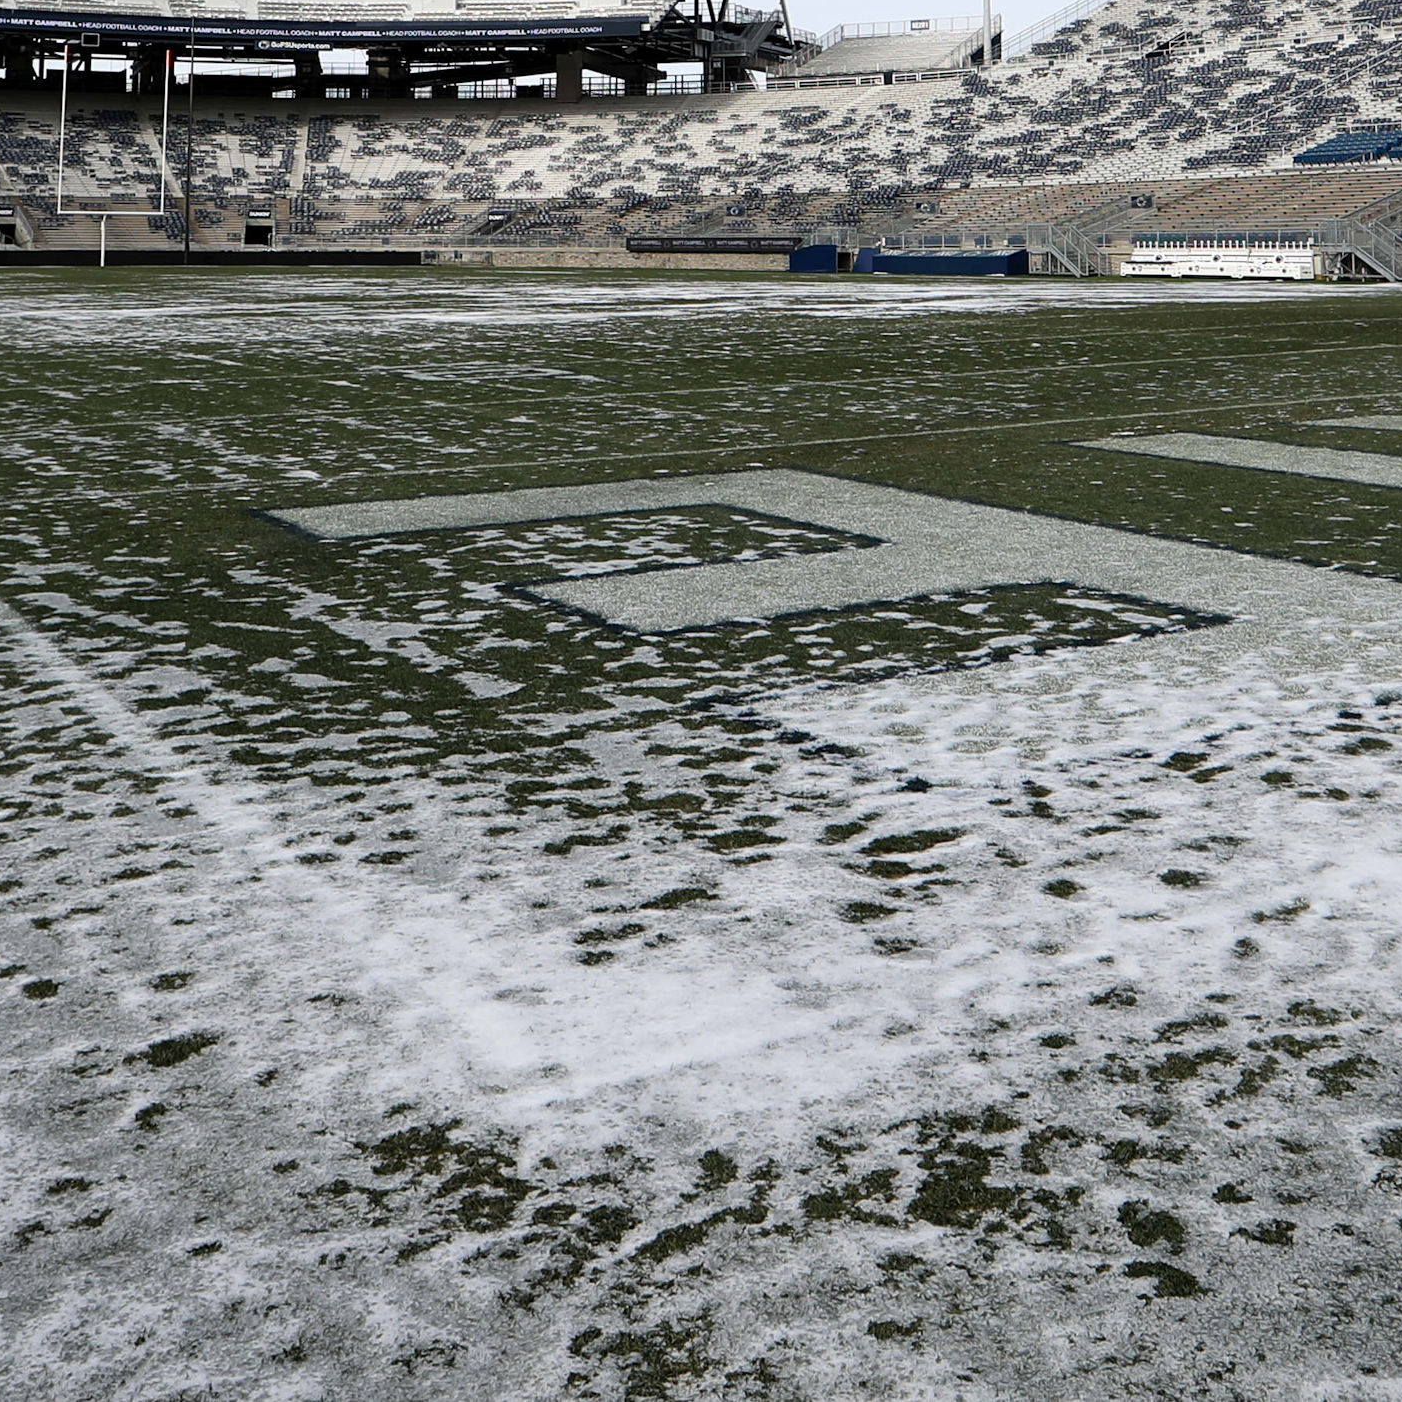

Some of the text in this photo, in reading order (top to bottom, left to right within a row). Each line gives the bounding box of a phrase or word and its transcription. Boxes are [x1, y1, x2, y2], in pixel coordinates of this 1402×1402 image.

[11, 18, 34, 26] MATT
[35, 19, 78, 28] CAMPBELL
[101, 23, 137, 31] FOOTBALL
[138, 24, 162, 32] COACH
[271, 41, 330, 50] GoPSUsports.com
